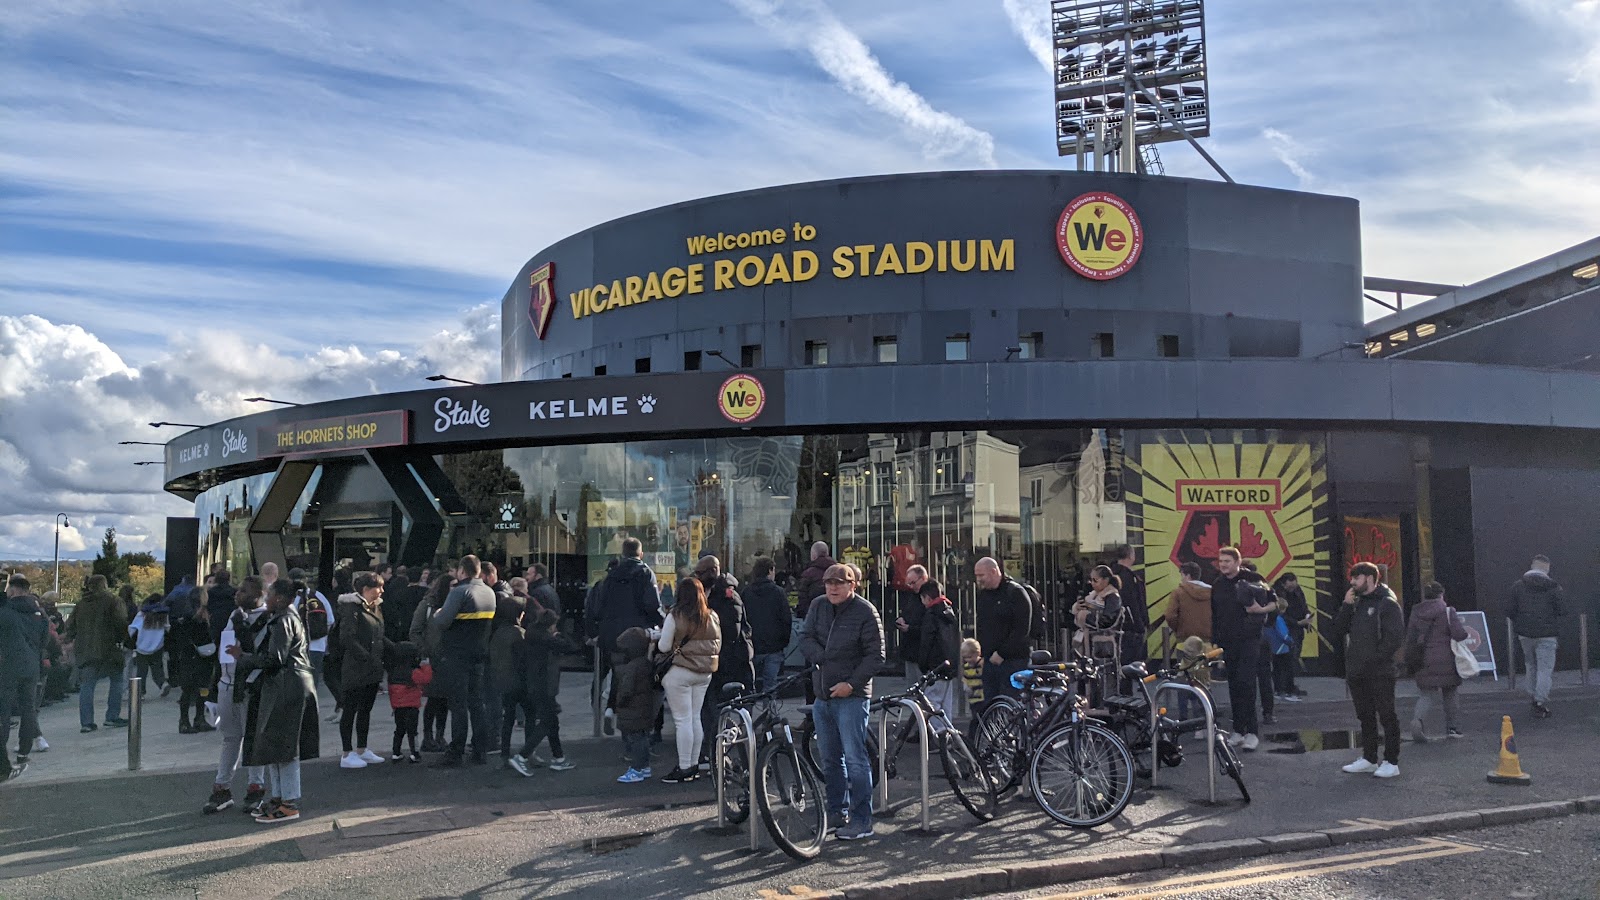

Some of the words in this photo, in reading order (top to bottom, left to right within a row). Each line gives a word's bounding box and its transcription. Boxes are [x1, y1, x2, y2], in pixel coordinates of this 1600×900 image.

[686, 228, 787, 256] Welcome
[793, 222, 817, 242] to
[1073, 222, 1127, 252] We
[569, 262, 704, 320] VICARAGE
[714, 249, 819, 291] ROAD
[832, 239, 1015, 280] STADIUM
[529, 396, 628, 420] KELME
[726, 390, 757, 407] We
[434, 397, 491, 433] Stake
[222, 427, 248, 458] Stake
[277, 431, 294, 447] THE
[297, 426, 344, 445] HORNETS
[346, 422, 377, 440] SHOP
[180, 444, 202, 464] KELME
[1187, 488, 1270, 503] WATFORD
[494, 522, 521, 530] KELME
